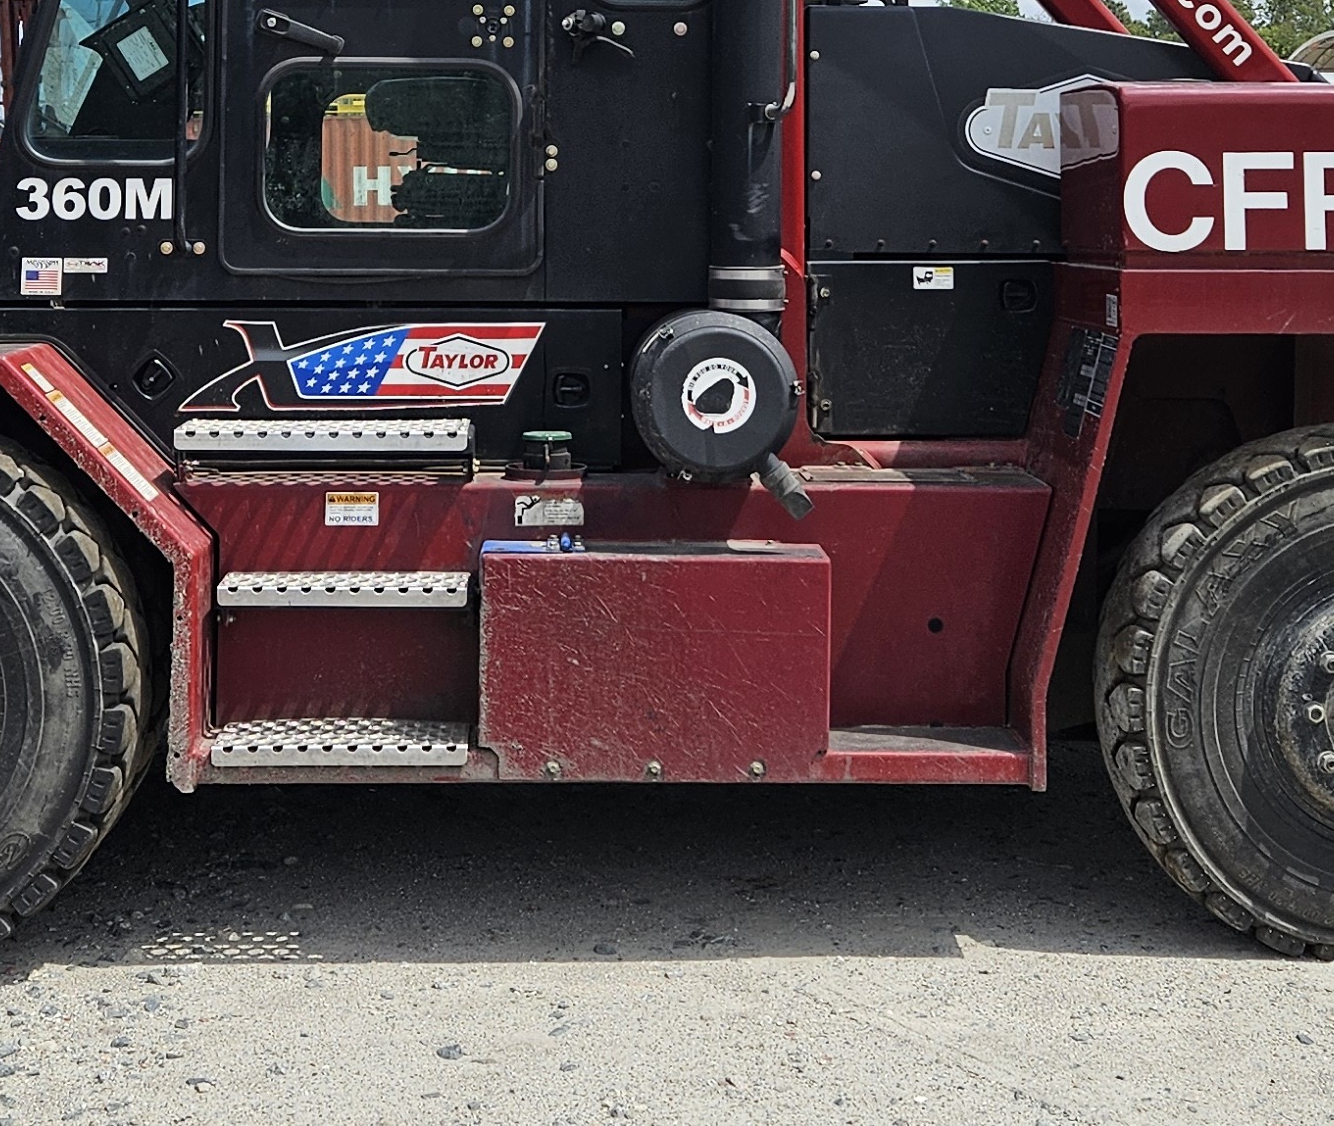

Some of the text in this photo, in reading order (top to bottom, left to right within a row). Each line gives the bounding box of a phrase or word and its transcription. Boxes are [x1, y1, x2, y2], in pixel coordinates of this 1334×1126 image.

[15, 177, 173, 221] 360M
[418, 345, 499, 370] TAYLOR
[337, 495, 376, 503] WARNING
[328, 515, 373, 523] NO RIDERS
